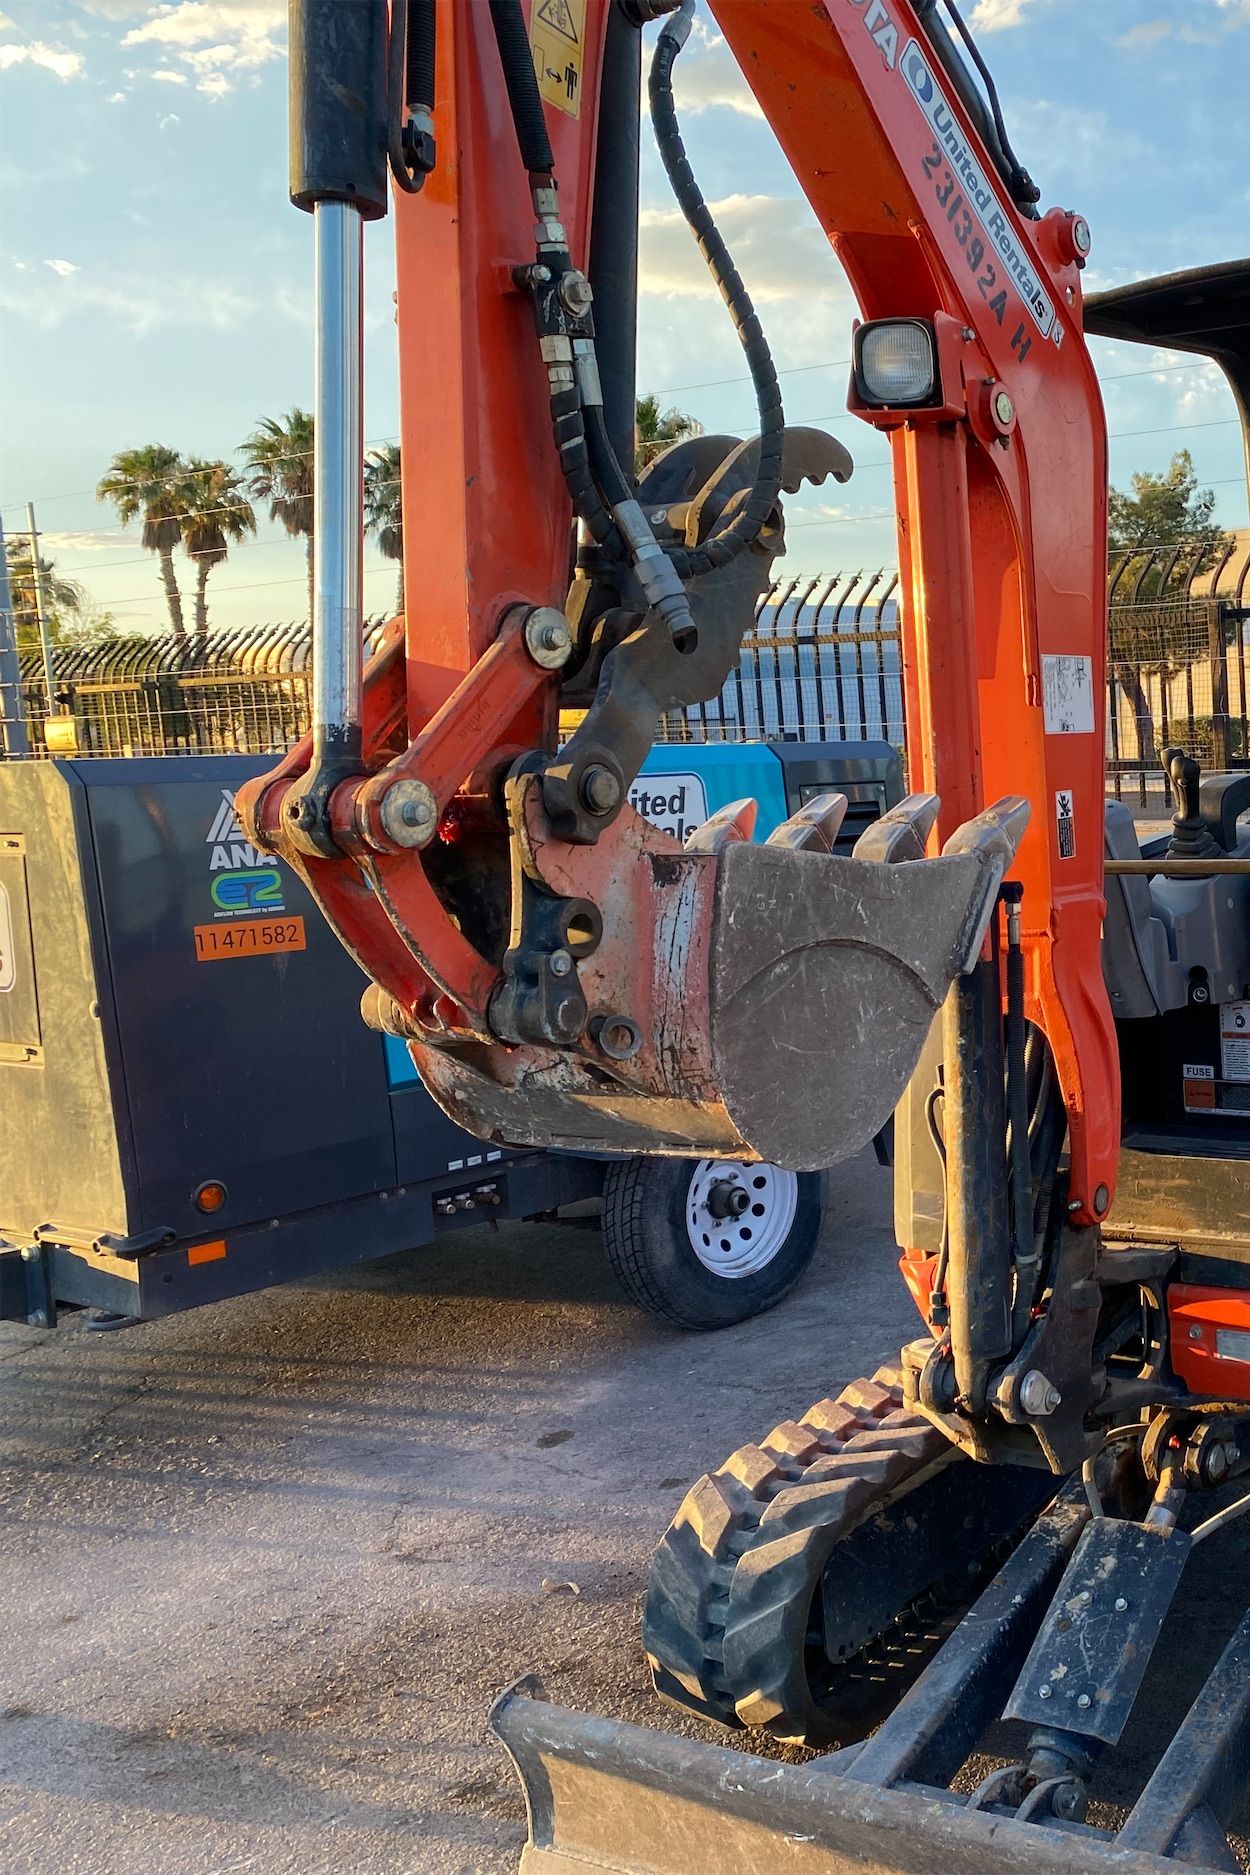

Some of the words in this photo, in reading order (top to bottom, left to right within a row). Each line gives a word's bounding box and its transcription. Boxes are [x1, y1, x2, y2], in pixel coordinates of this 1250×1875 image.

[852, 0, 899, 71] TA
[932, 102, 991, 212] United
[986, 210, 1049, 320] Rentals
[631, 786, 686, 816] ited
[209, 843, 278, 871] ANA
[195, 924, 299, 952] 11471582
[1186, 1067, 1212, 1077] FUSE
